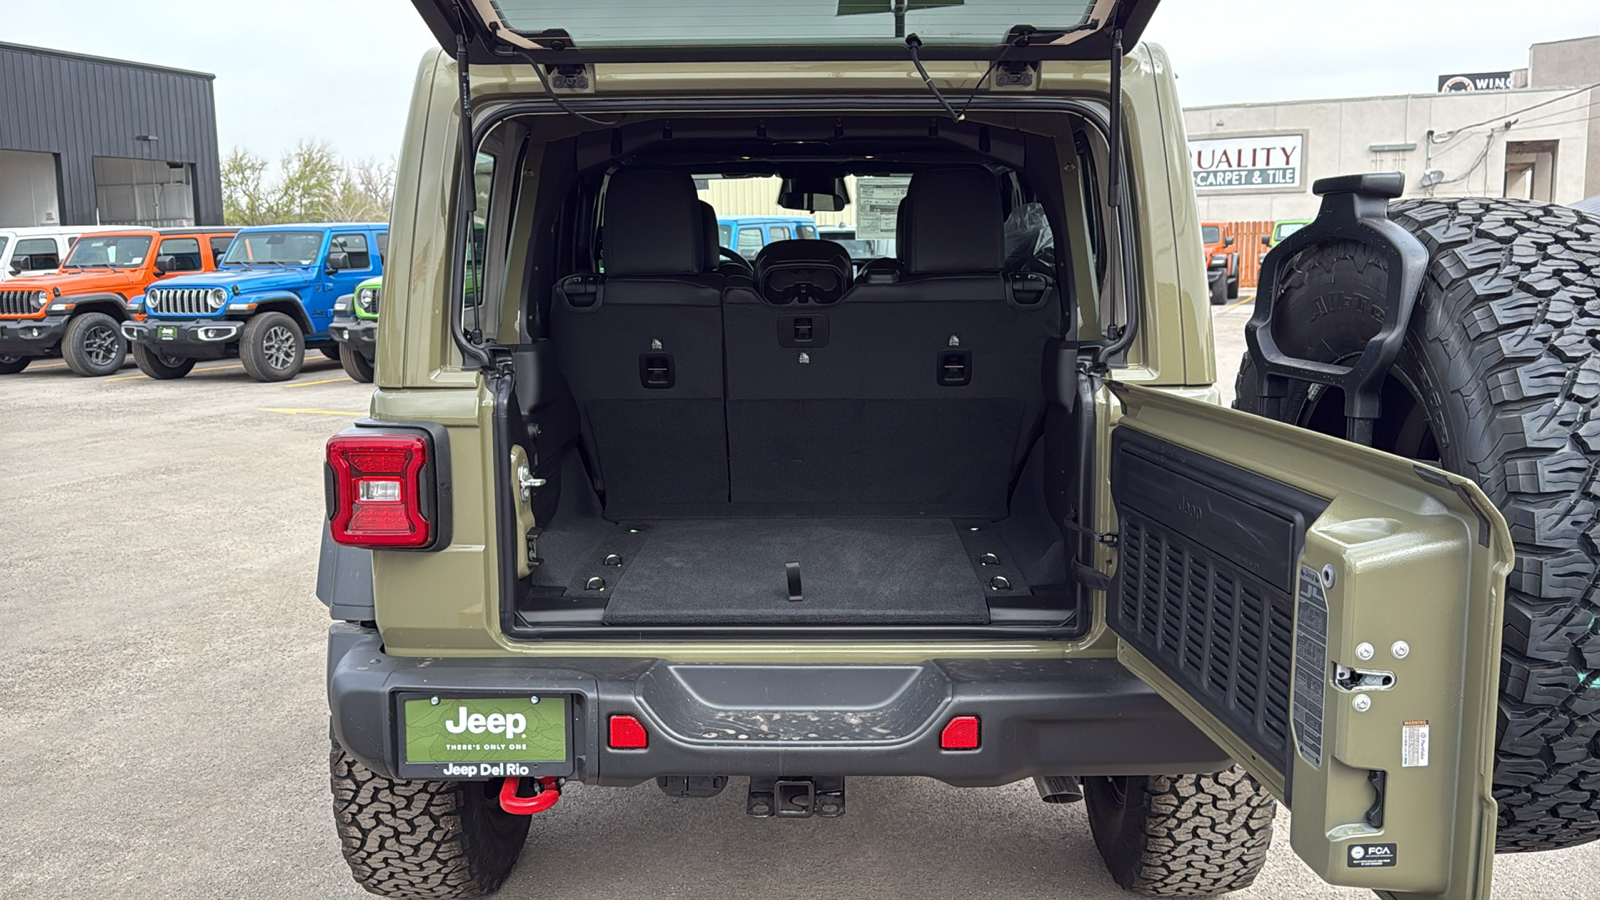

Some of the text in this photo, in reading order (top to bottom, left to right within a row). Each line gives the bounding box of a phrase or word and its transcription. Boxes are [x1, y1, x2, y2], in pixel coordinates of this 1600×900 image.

[1188, 146, 1297, 170] UALITY
[1196, 169, 1294, 186] CARPET & TILE
[445, 706, 527, 739] Jeep
[443, 763, 529, 777] Jeep Del Rio
[1368, 846, 1390, 855] FCA
